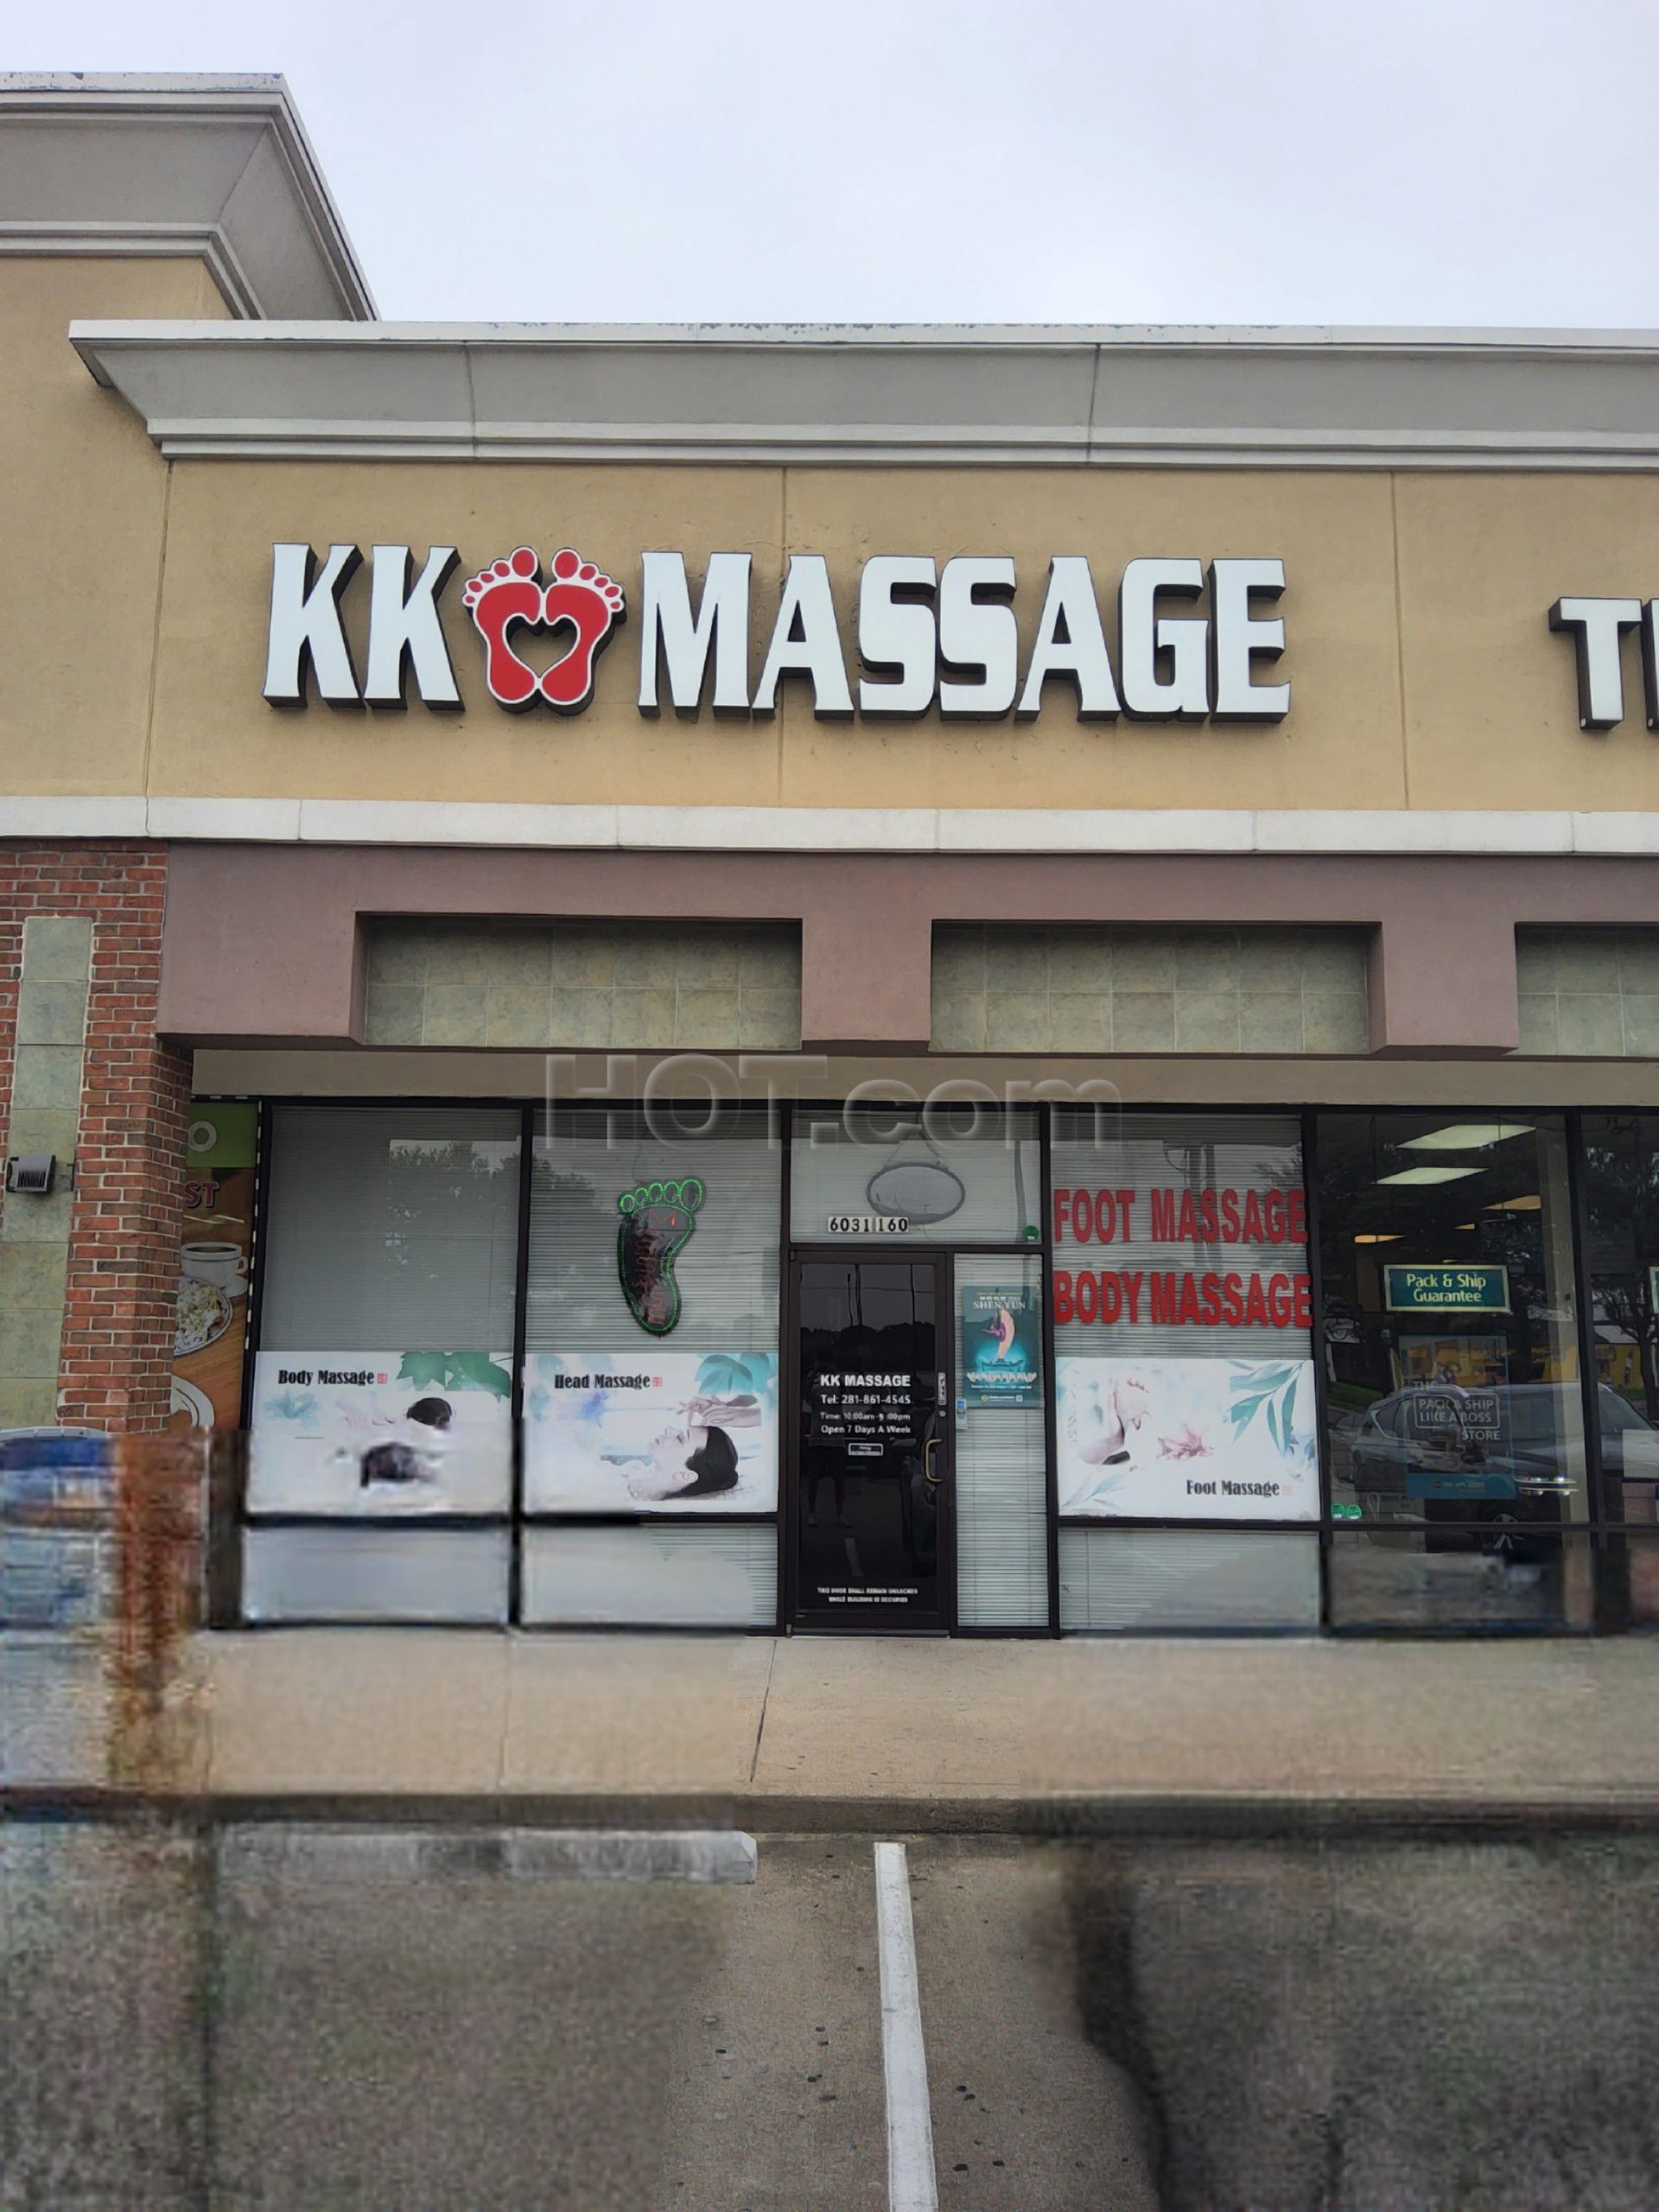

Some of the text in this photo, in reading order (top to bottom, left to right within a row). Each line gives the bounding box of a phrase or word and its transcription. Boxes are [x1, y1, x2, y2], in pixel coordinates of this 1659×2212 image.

[263, 543, 1291, 721] KK MASSAGE
[1548, 596, 1659, 730] T
[830, 1217, 908, 1232] 6031 160
[1053, 1189, 1308, 1244] FOOT MASSAGE
[1407, 1274, 1486, 1291] Pack & Ship
[1053, 1271, 1313, 1328] BODY MASSAGE
[1413, 1288, 1482, 1302] Guarantee
[277, 1370, 314, 1386] Body
[317, 1370, 375, 1386] Massage
[554, 1374, 589, 1389] Head
[594, 1374, 651, 1390] Massage
[821, 1375, 911, 1387] KK MASSAGE
[1465, 1399, 1494, 1410] SHIP
[821, 1425, 844, 1435] Open
[855, 1425, 875, 1435] Days
[1462, 1430, 1501, 1440] STORE
[1186, 1480, 1280, 1497] Foot Massage
